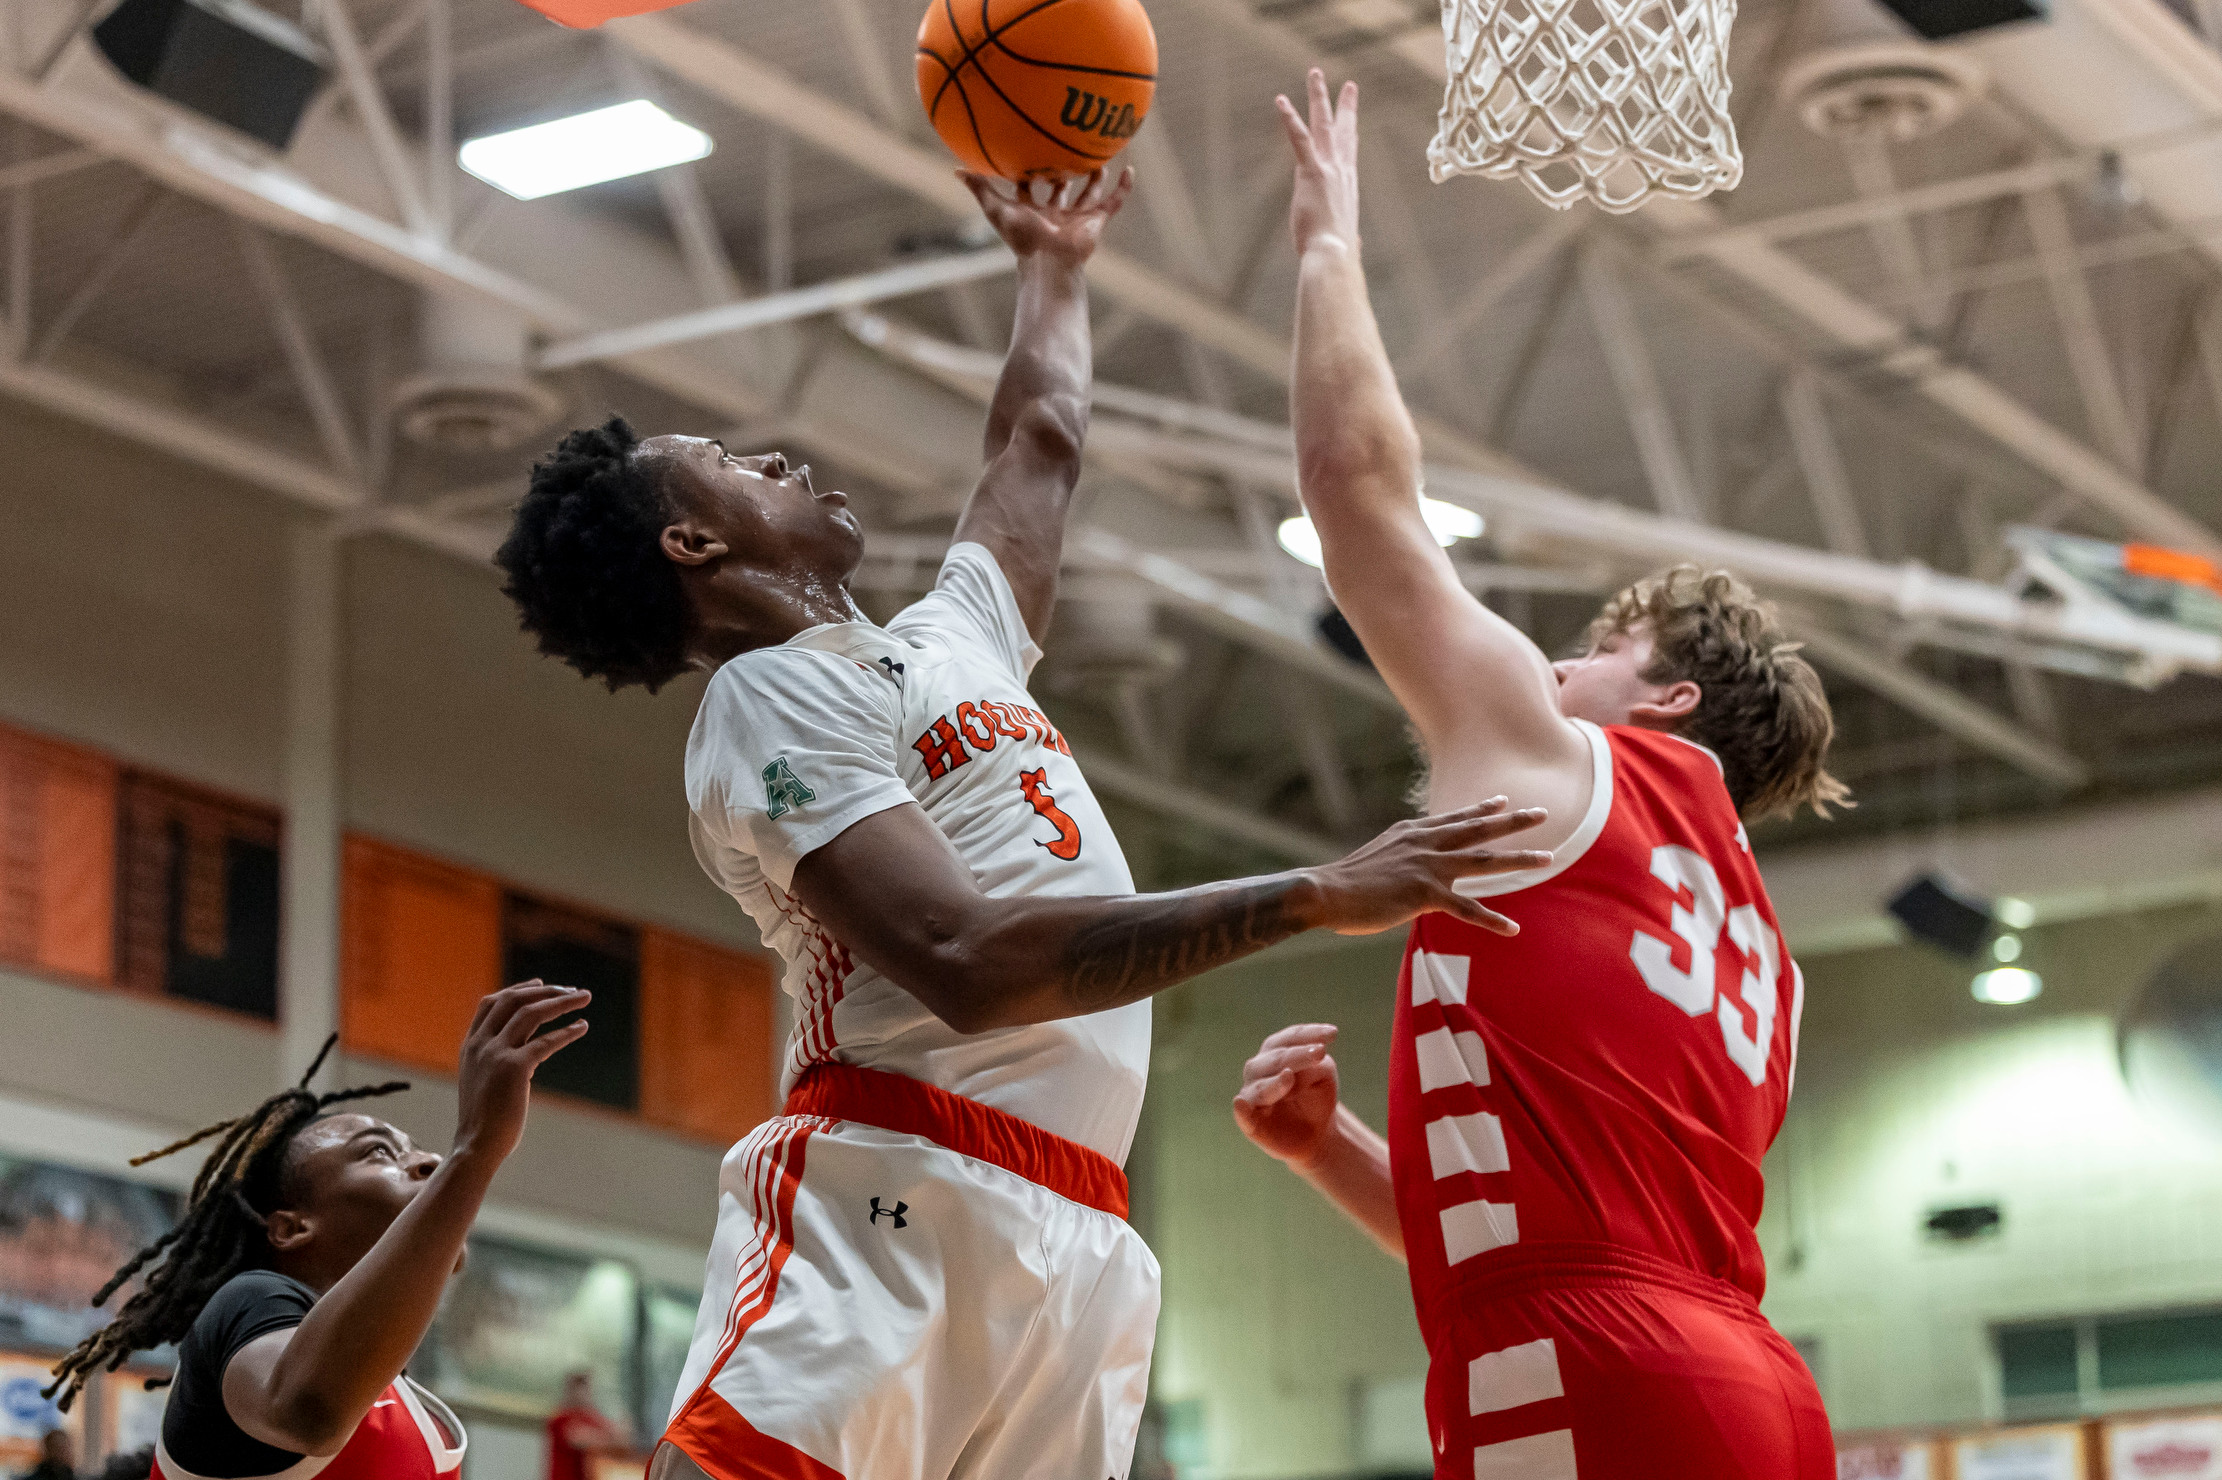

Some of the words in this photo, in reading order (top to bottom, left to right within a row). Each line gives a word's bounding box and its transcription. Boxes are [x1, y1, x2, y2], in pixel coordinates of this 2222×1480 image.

[762, 756, 816, 821] A
[1019, 767, 1082, 861] 5
[1630, 843, 1782, 1087] 33
